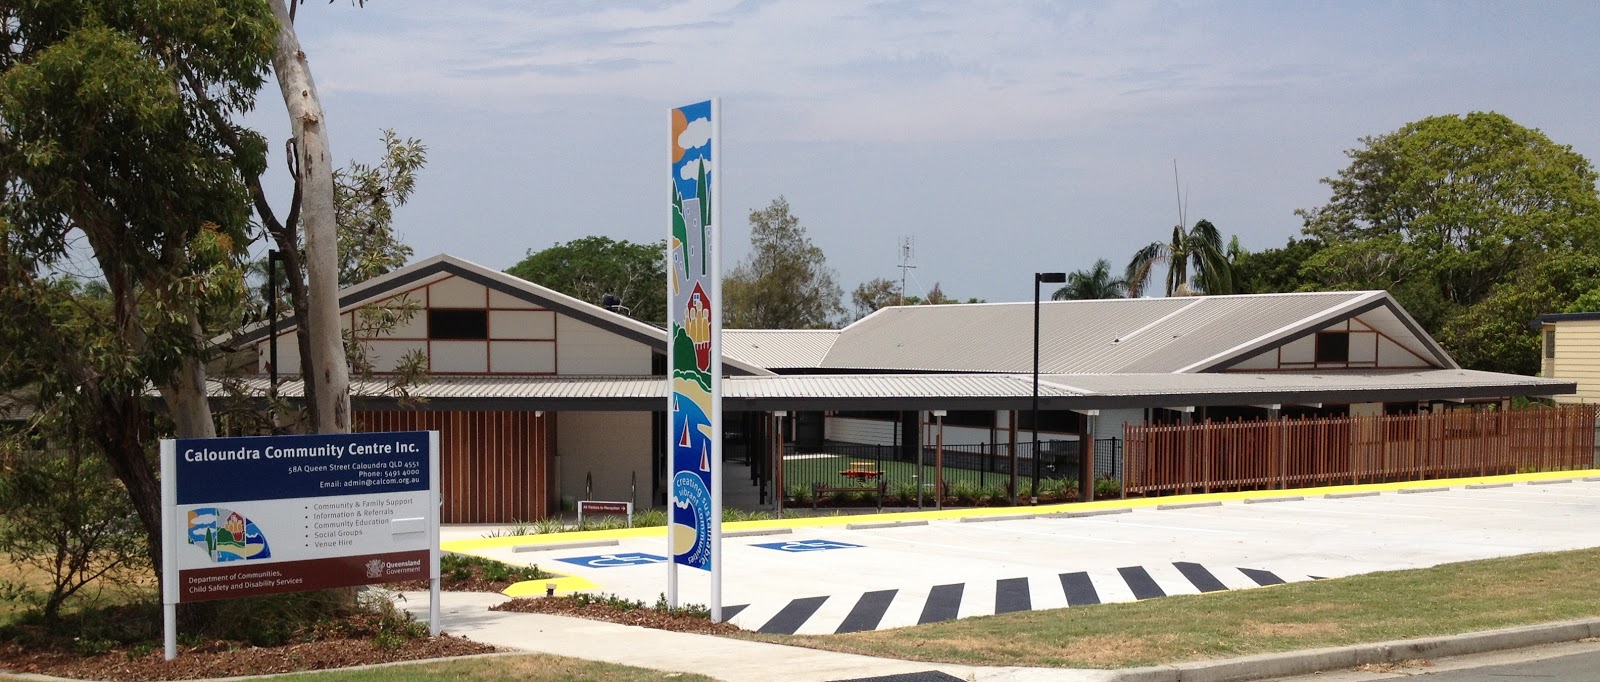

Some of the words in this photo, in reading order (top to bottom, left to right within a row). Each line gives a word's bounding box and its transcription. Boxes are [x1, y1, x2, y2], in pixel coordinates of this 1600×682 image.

[184, 446, 260, 462] Caloundra
[264, 444, 344, 459] Community
[348, 442, 392, 455] Centre
[396, 441, 420, 453] Inc.
[288, 465, 302, 474] 58A
[304, 464, 328, 473] Queen
[329, 463, 350, 471] Street
[352, 461, 387, 470] Caloundra
[388, 460, 403, 468] QLD
[358, 470, 382, 478] Phone:
[343, 477, 419, 487] admin@calcom.org.au
[676, 477, 703, 498] creating
[678, 487, 699, 506] vibrant
[313, 502, 353, 511] Community
[362, 499, 385, 508] Family
[386, 498, 413, 507] Support
[313, 510, 354, 520] Information
[363, 508, 394, 516] Referrals
[313, 520, 353, 529] Community
[355, 518, 389, 526] Education
[314, 530, 336, 539] Social
[337, 529, 363, 537] Groups
[687, 507, 705, 564] communities
[386, 559, 421, 569] Queensland
[386, 566, 421, 575] Government
[188, 574, 228, 585] Department
[237, 570, 282, 580] Communities,
[188, 586, 207, 594] Child
[208, 583, 229, 592] Safety
[230, 582, 243, 590] and
[244, 579, 275, 589] Disability
[276, 577, 303, 586] Services
